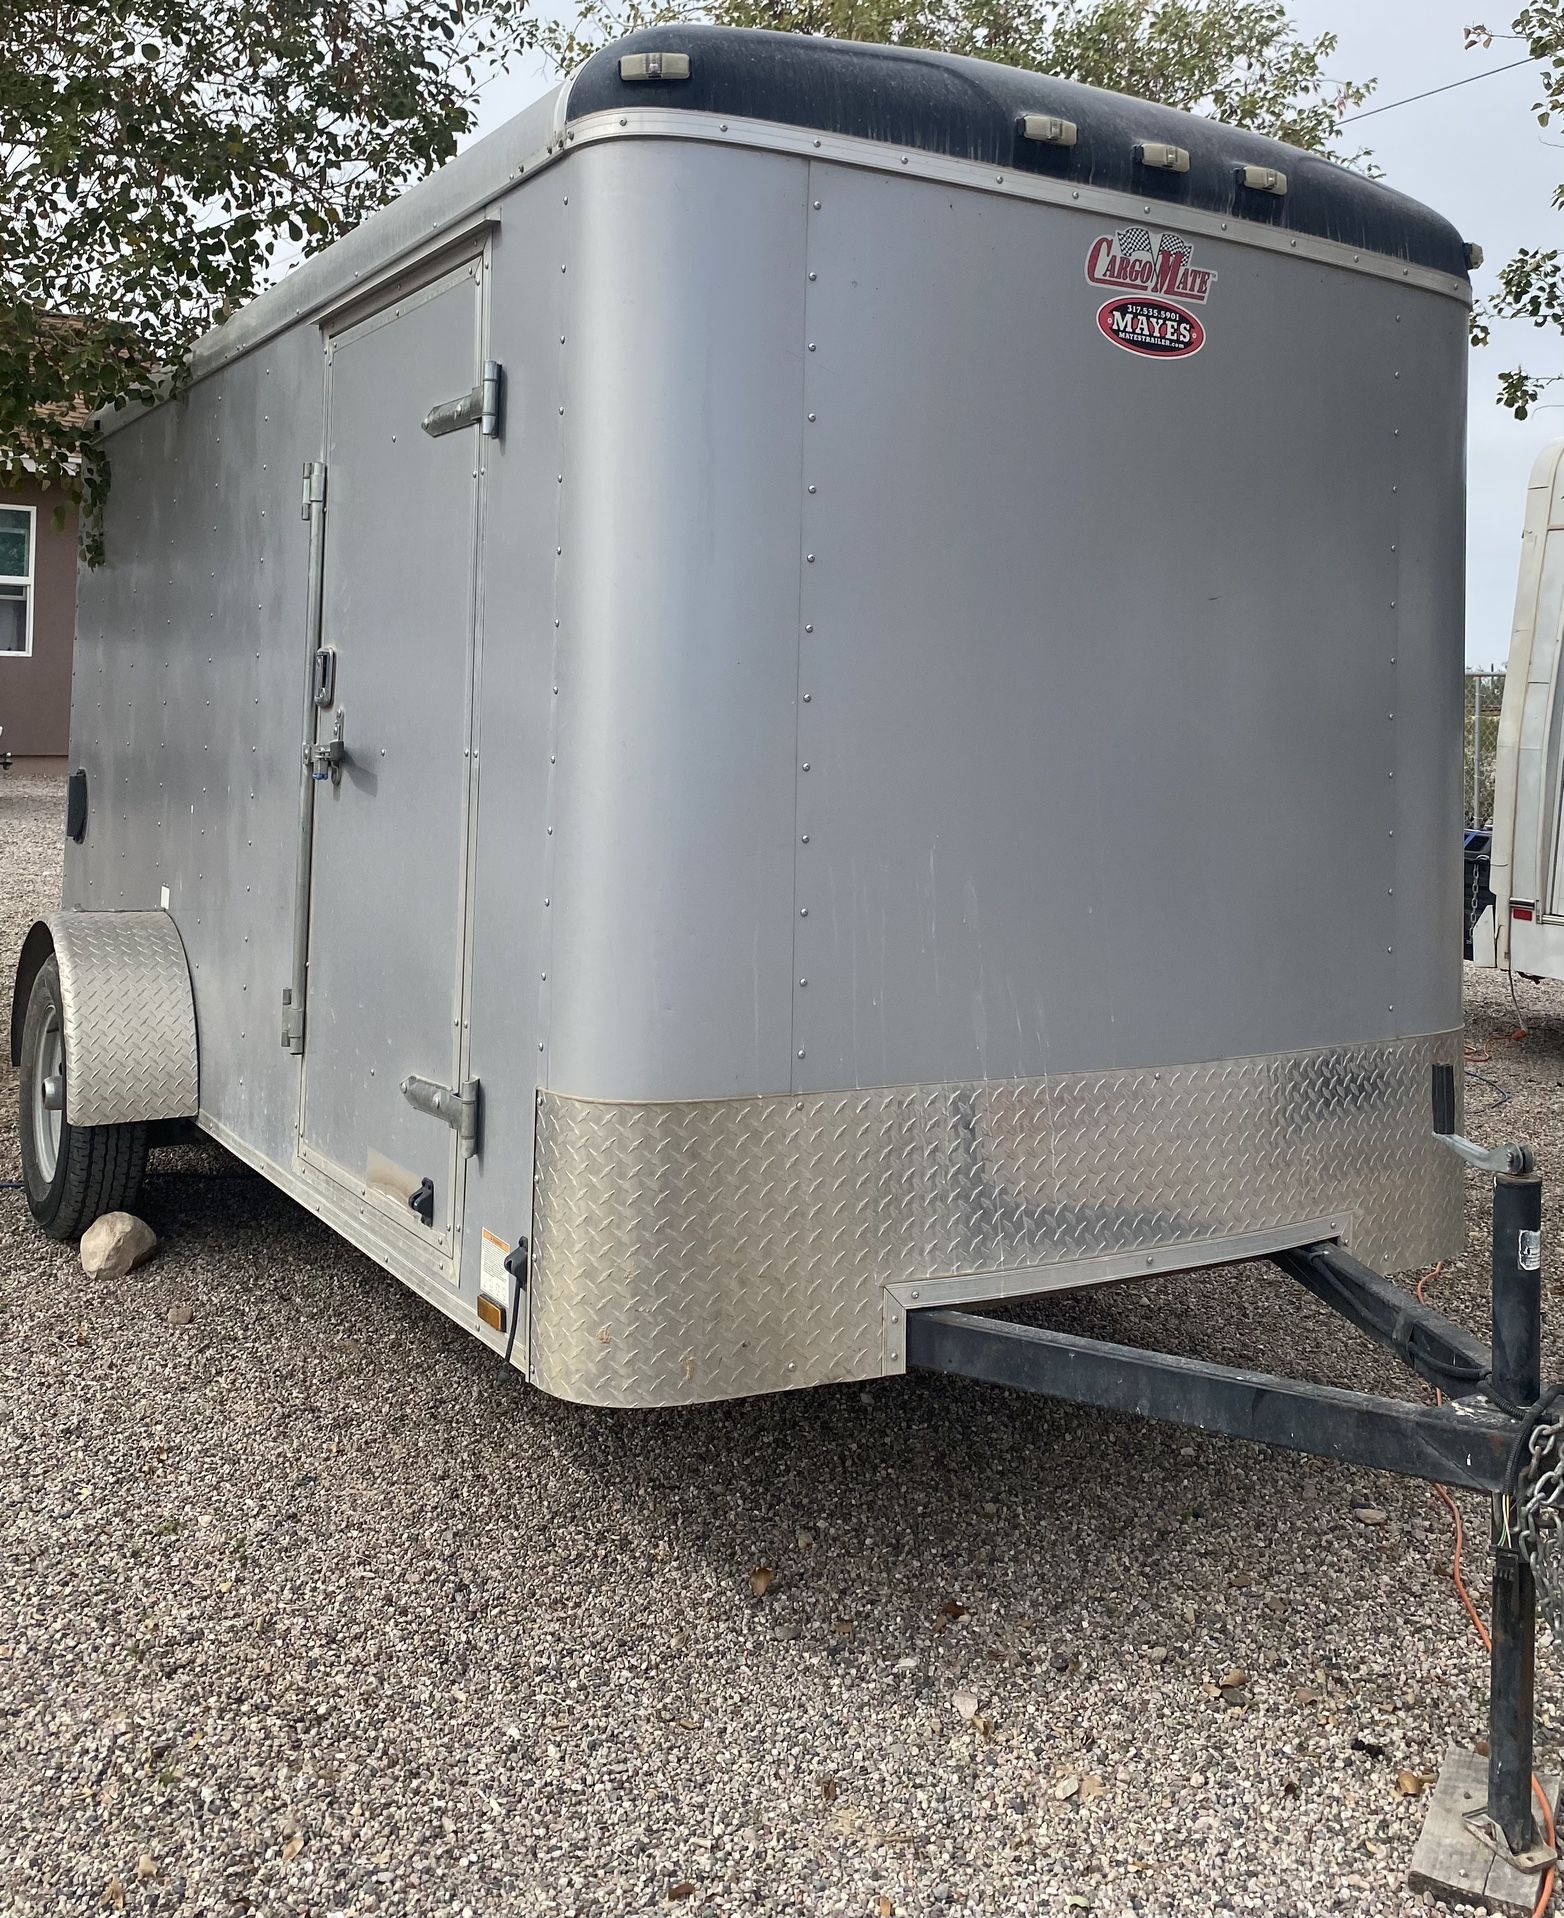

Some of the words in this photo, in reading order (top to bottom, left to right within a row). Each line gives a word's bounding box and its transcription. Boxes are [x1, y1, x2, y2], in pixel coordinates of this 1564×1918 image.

[1127, 304, 1180, 321] 317.535.5901
[1112, 311, 1190, 342] MAYES
[1118, 331, 1185, 349] MAYESTRAILER.com
